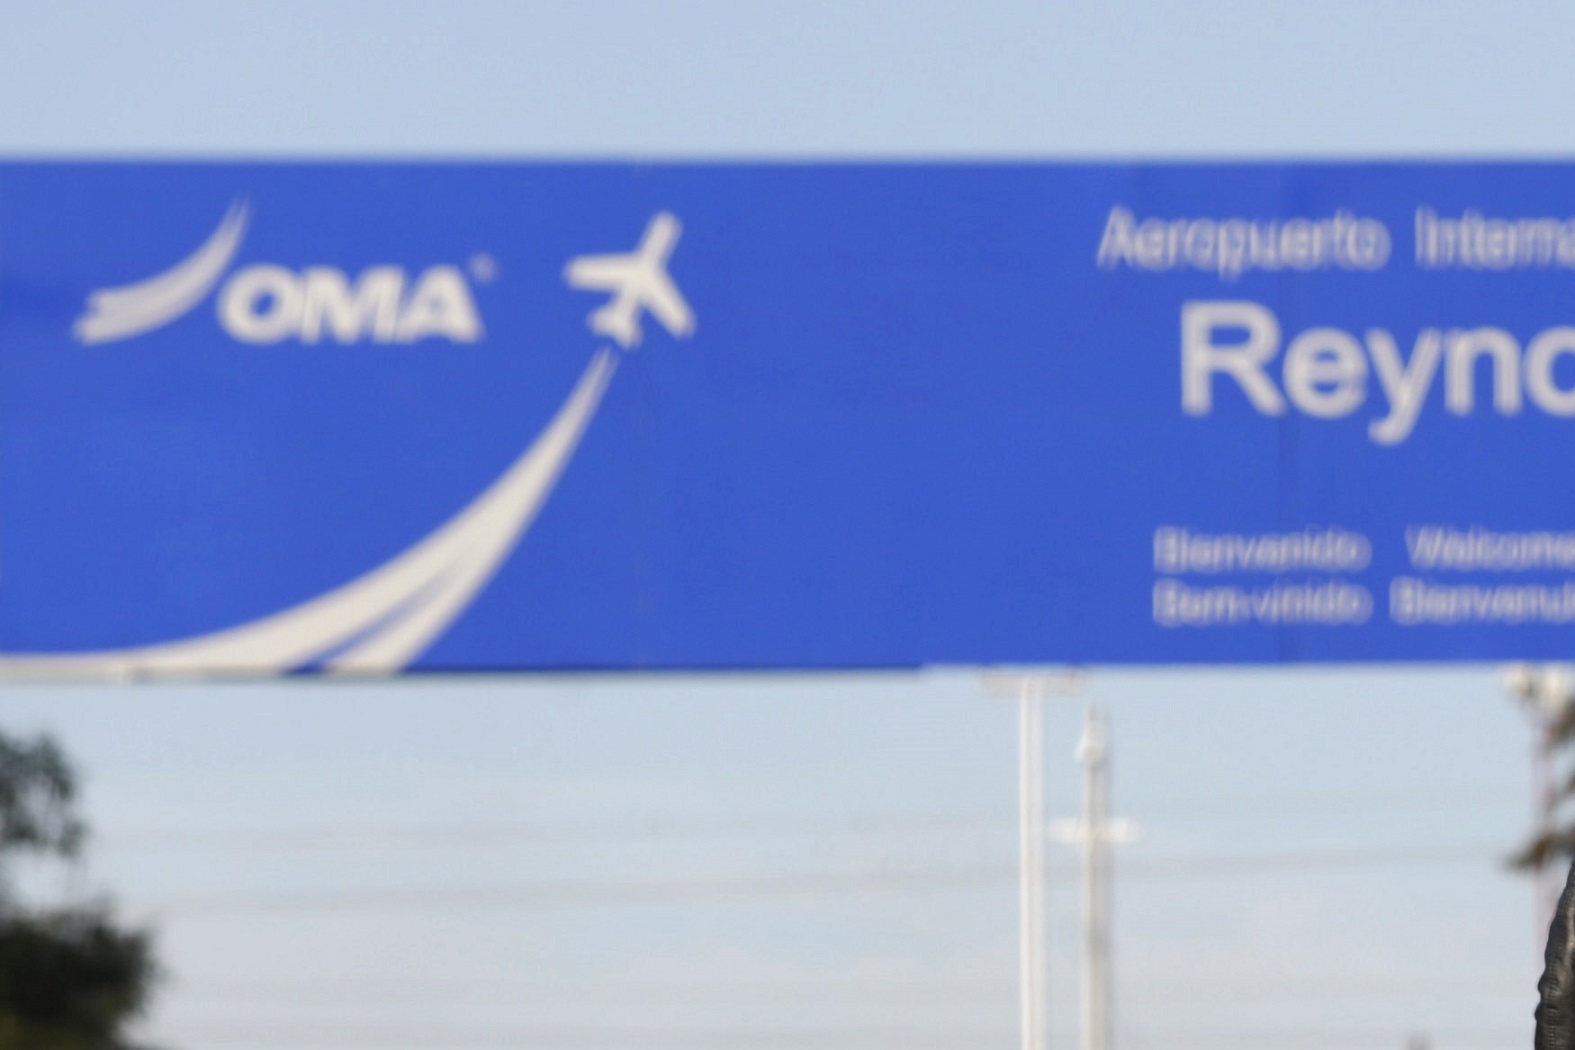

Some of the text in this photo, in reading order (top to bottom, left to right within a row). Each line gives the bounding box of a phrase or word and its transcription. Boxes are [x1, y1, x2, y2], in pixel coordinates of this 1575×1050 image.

[1097, 205, 1391, 279] Aeropuerto
[217, 262, 488, 345] OMA
[1153, 526, 1371, 573] Bienvenido
